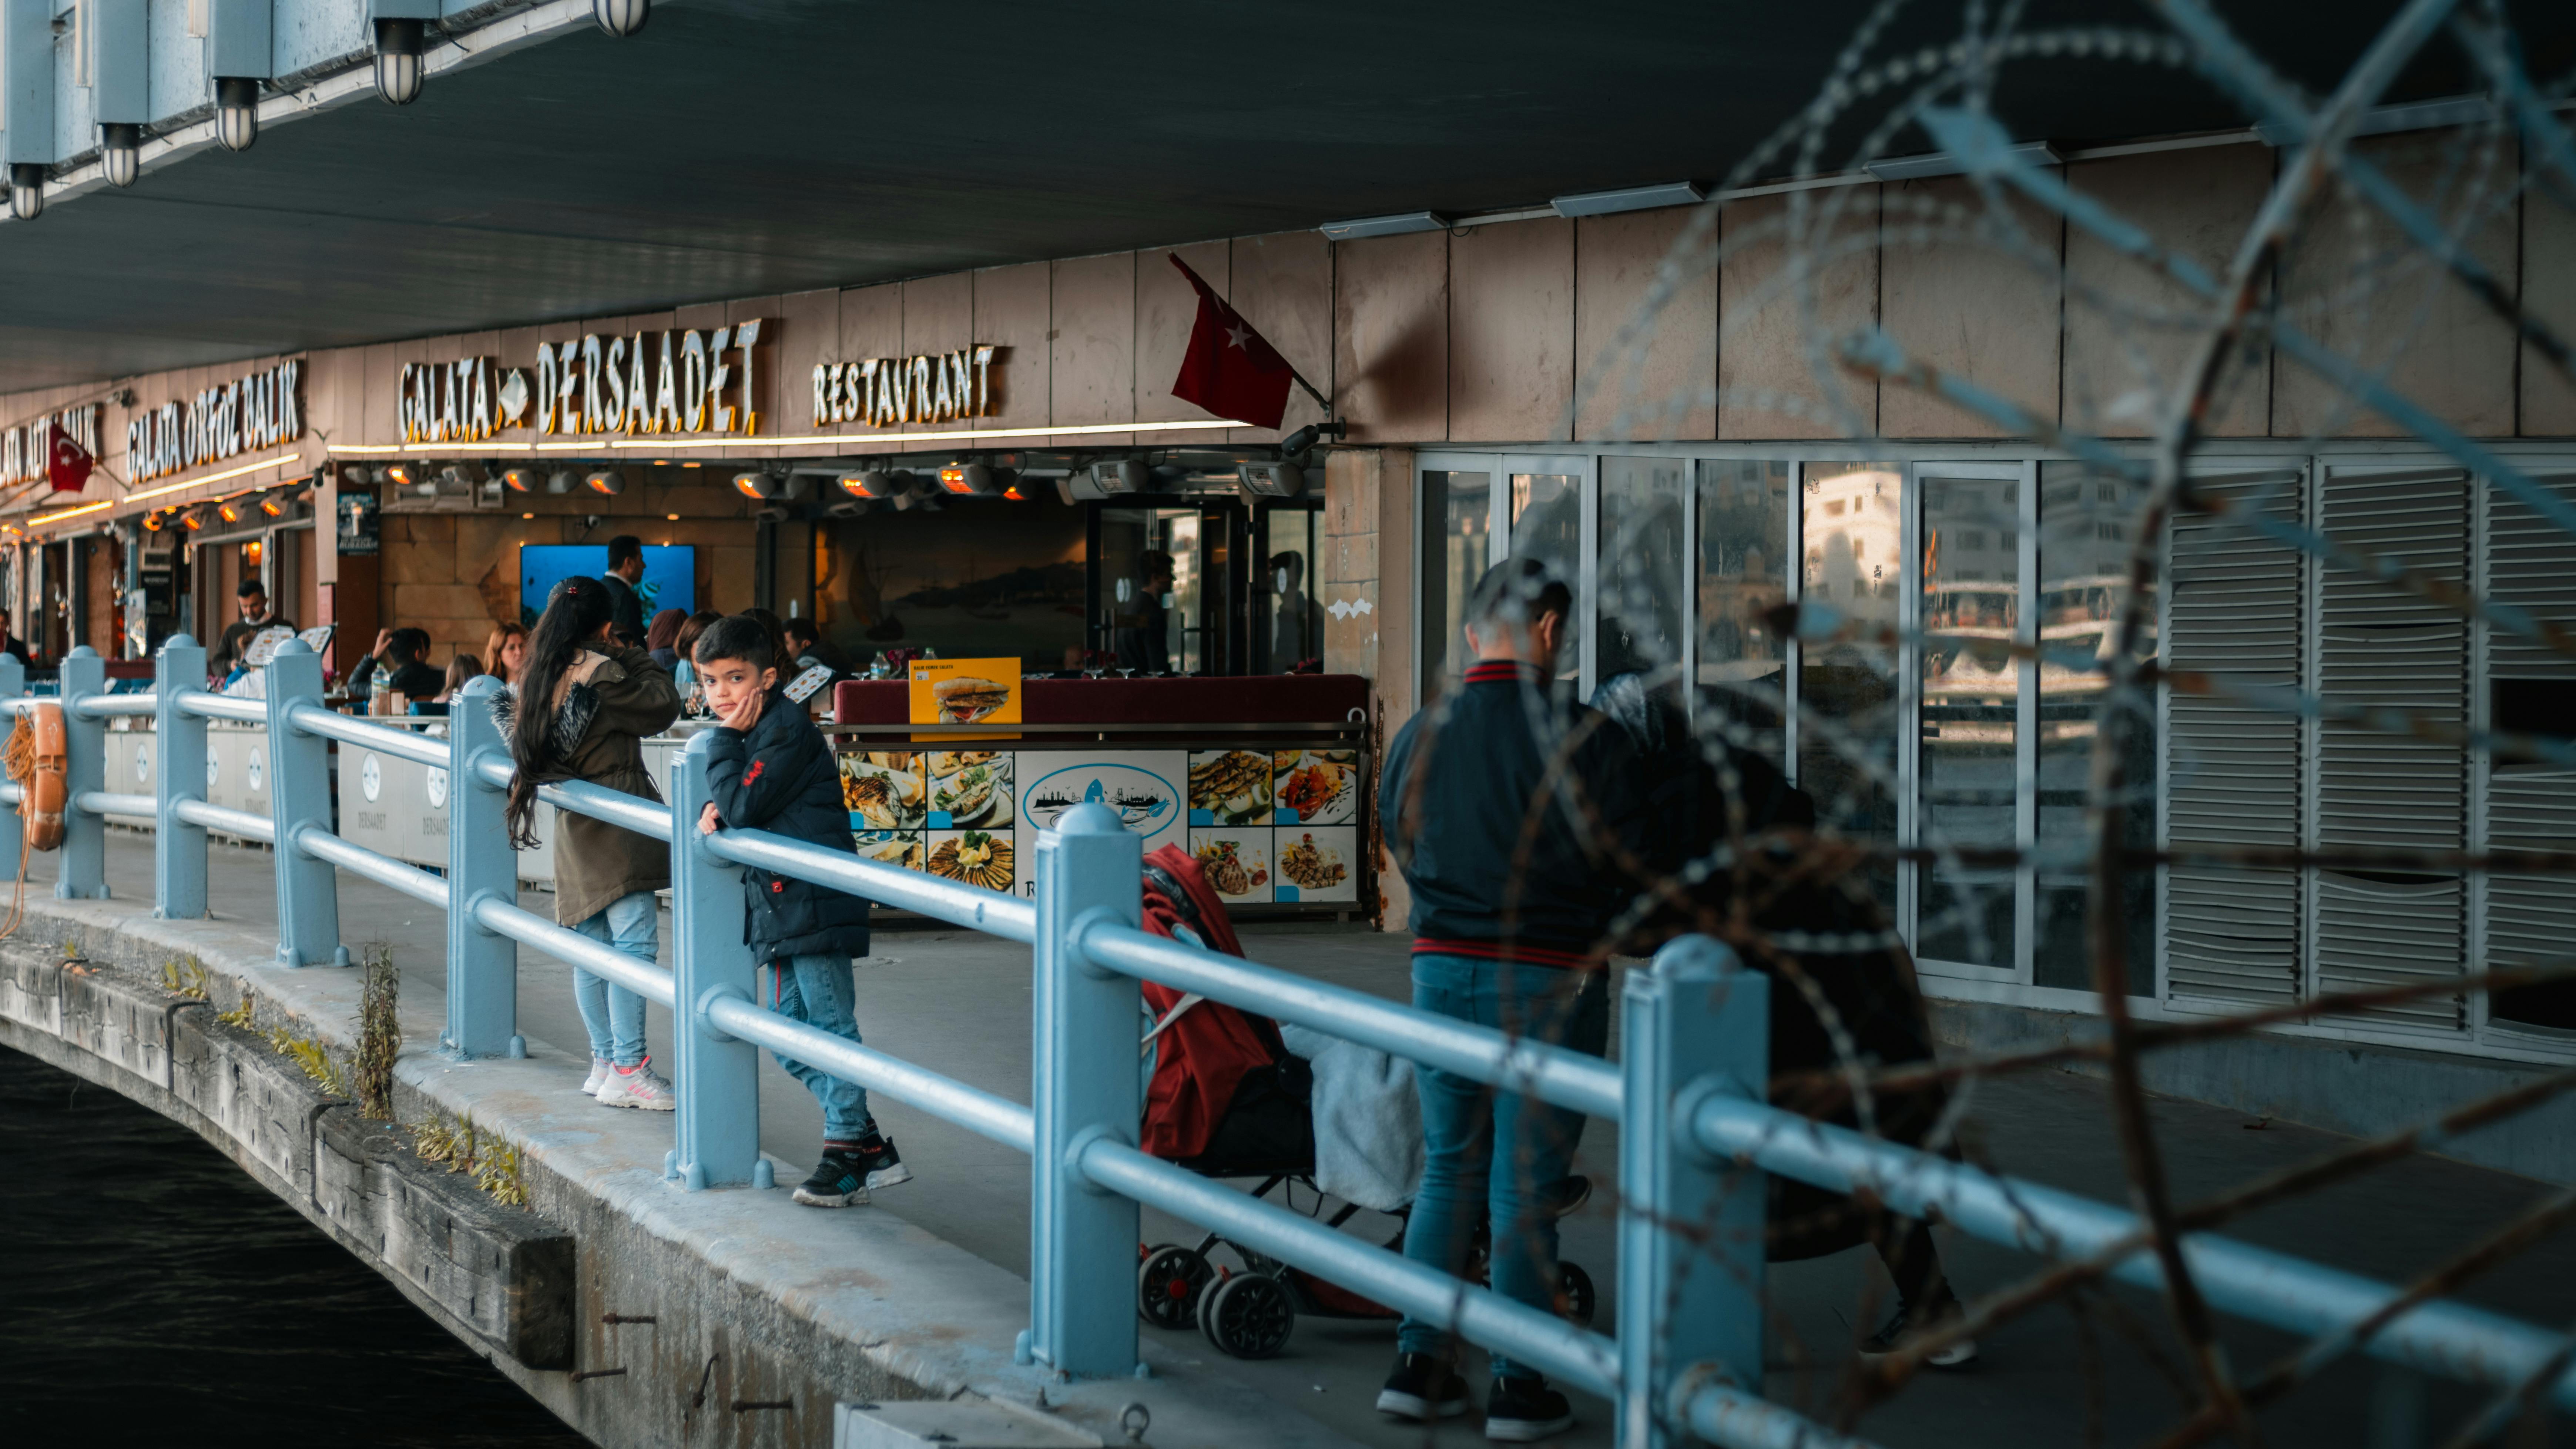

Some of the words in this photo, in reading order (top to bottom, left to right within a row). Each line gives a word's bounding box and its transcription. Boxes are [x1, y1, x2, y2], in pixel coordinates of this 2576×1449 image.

[127, 401, 181, 486] GALATA
[242, 359, 298, 452] BALIK
[399, 355, 491, 443] GALATA
[536, 318, 761, 436] DERSAADET
